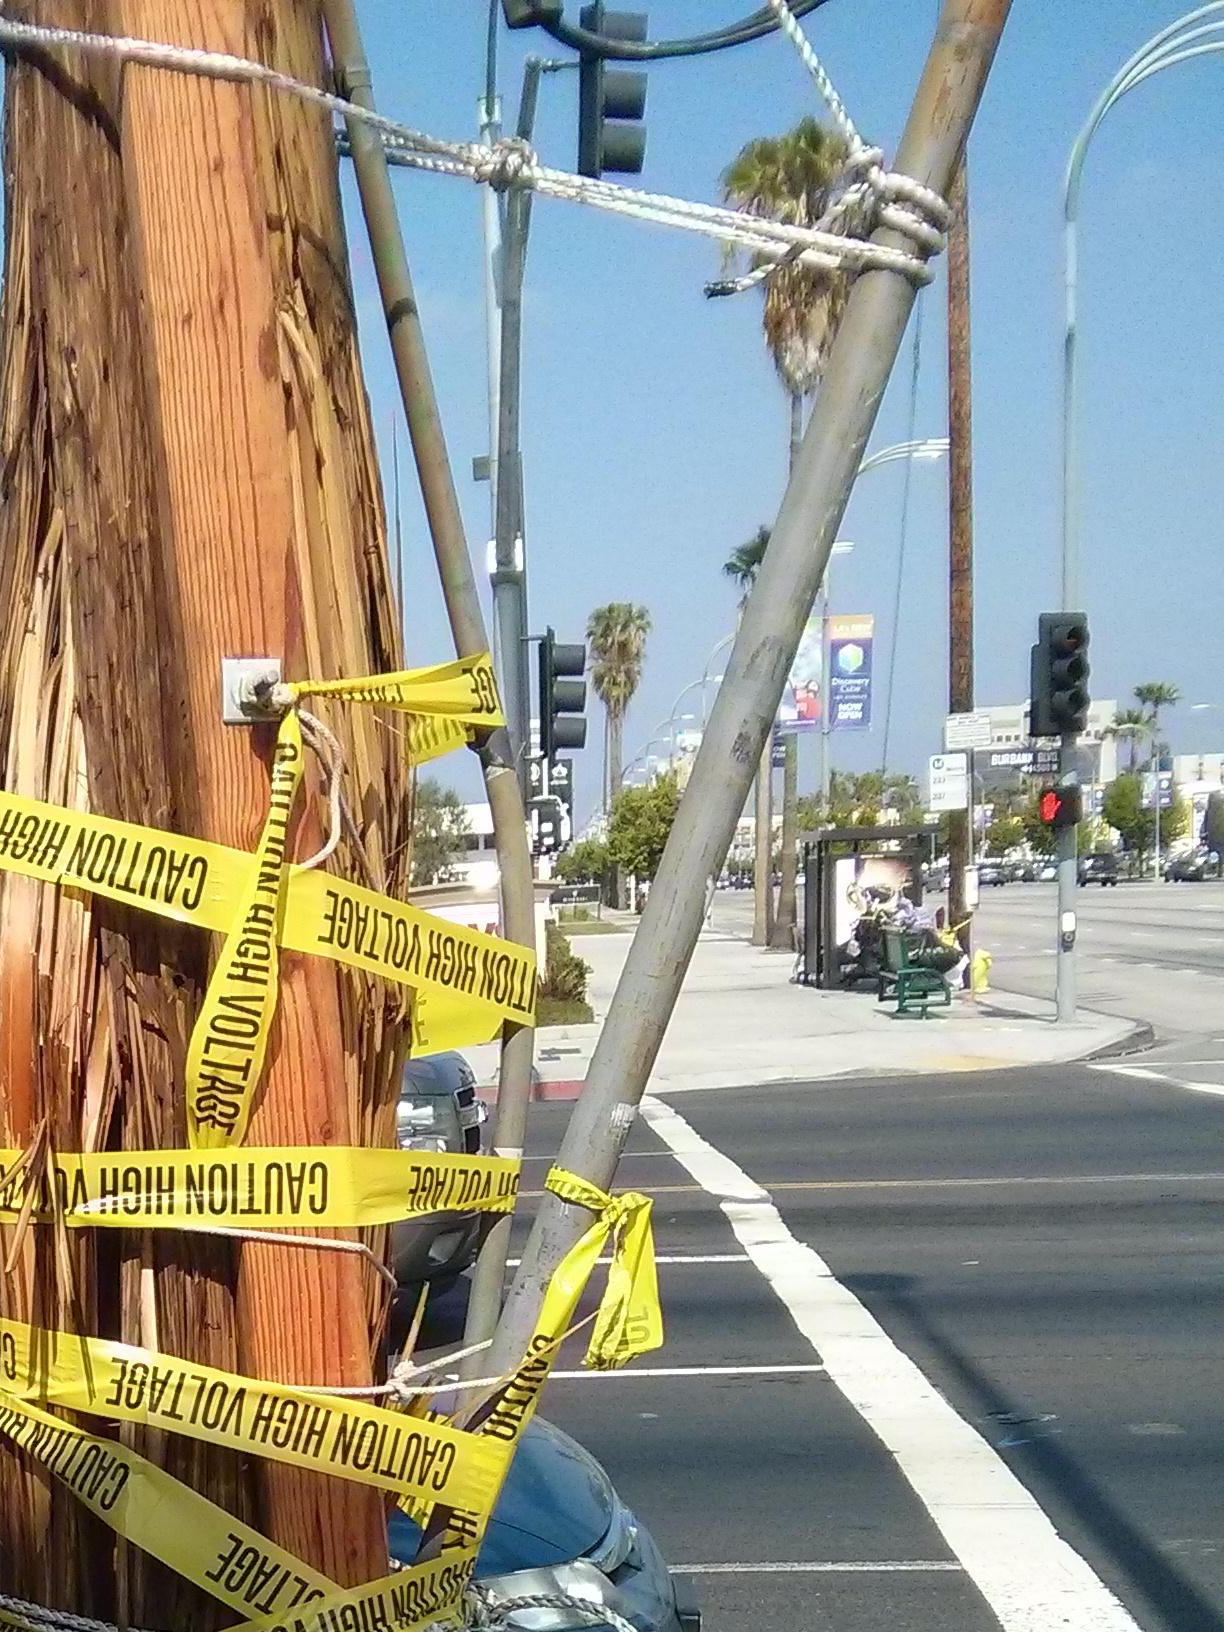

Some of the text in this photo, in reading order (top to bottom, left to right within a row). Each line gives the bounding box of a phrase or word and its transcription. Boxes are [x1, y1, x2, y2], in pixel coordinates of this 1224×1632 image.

[991, 752, 1034, 766] BURBANK
[65, 826, 209, 911] CAUTION
[195, 742, 300, 1138] CAUTION HIGH VOLTAGE
[317, 889, 537, 1014] TION HIGH VOLTAGE
[99, 1165, 175, 1216] HIGH
[185, 1161, 329, 1216] CAUTION
[407, 1165, 492, 1212] VOLTAGE
[105, 1356, 457, 1493] CAUTION HIGH VOLTAGE
[482, 1334, 555, 1441] CAUTIO
[26, 1419, 131, 1511] CAUTION
[204, 1532, 326, 1616] OLTAGE
